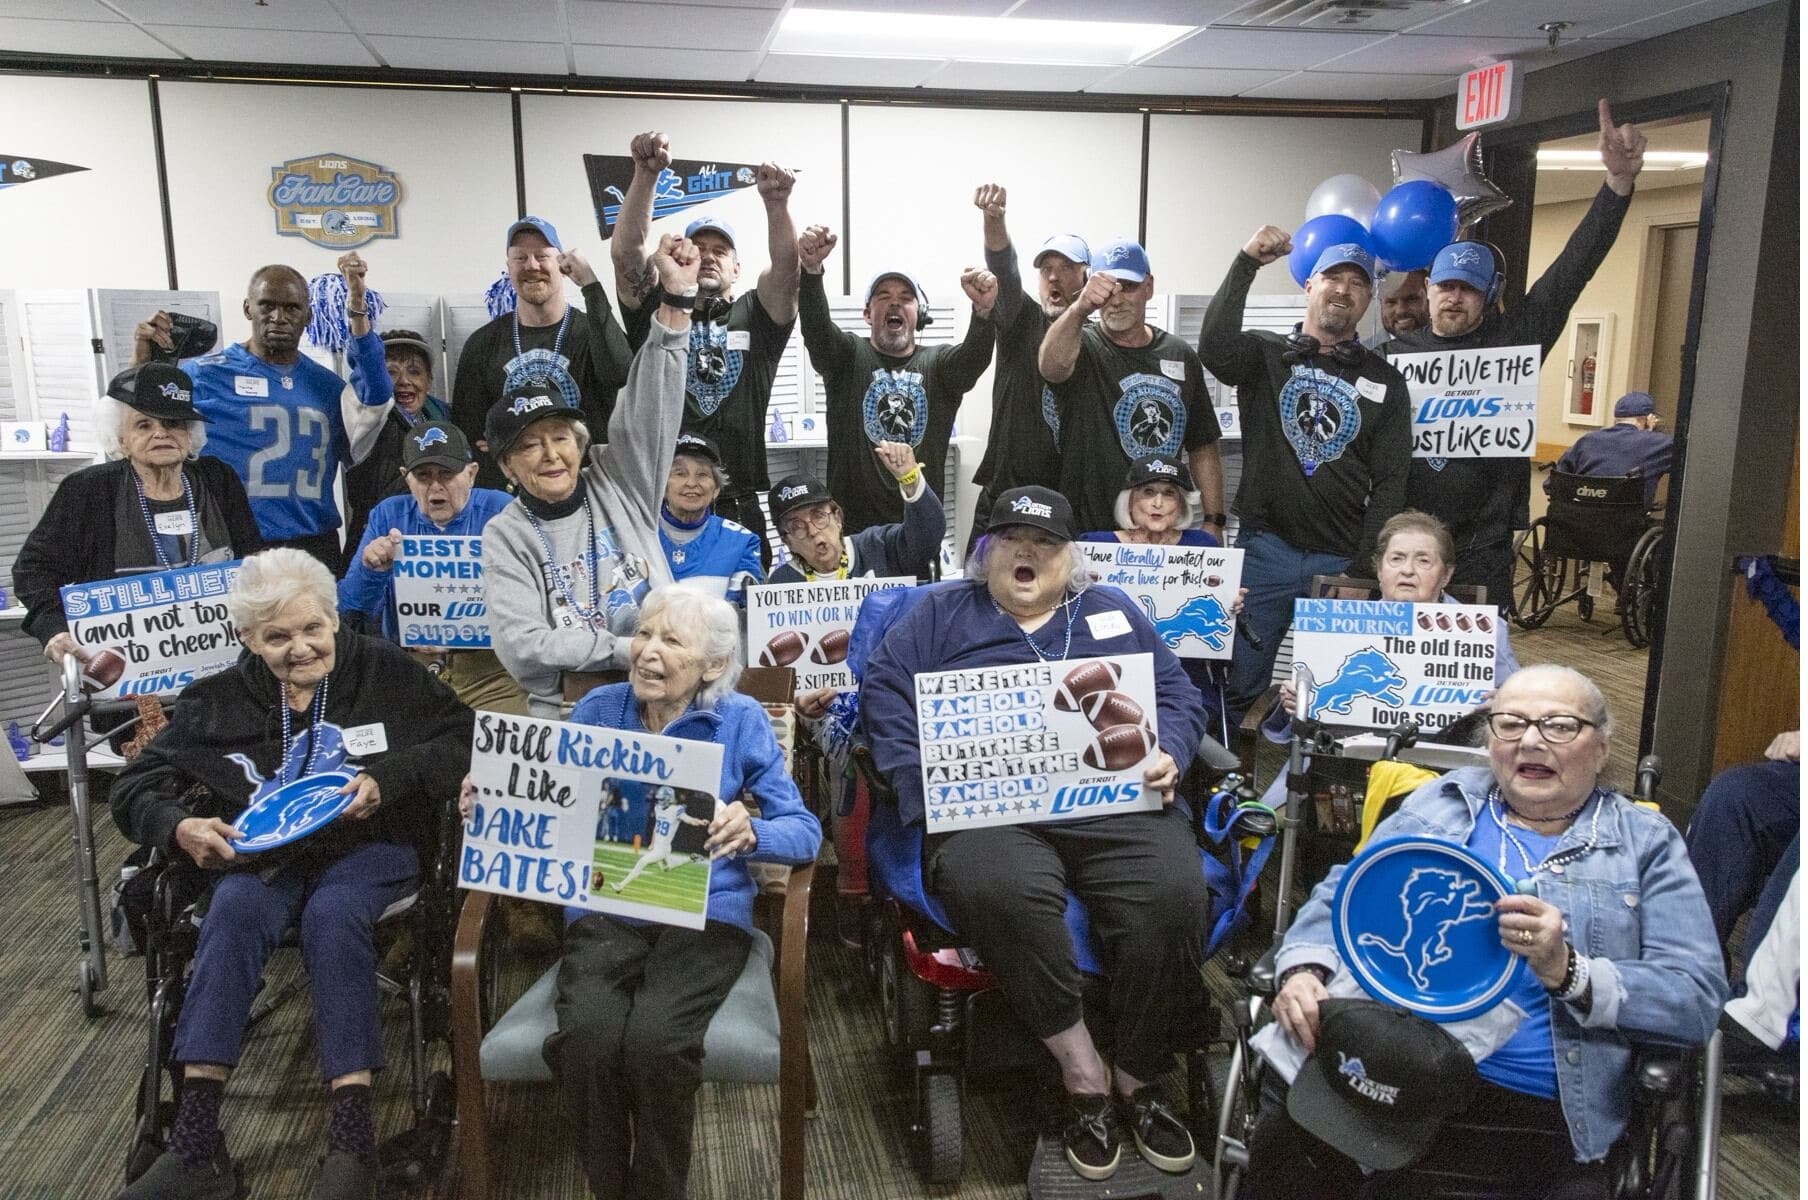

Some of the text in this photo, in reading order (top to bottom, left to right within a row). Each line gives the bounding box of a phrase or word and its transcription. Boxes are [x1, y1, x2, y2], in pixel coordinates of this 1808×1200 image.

[1465, 64, 1506, 123] EXIT
[687, 171, 732, 193] GRIT
[699, 164, 718, 177] ALL
[1495, 355, 1534, 385] THE
[1444, 389, 1481, 397] DETROIT
[1415, 397, 1504, 424] LIONS
[1495, 418, 1534, 452] US)
[247, 404, 330, 499] 23
[1576, 485, 1608, 498] drive
[403, 539, 464, 557] BEST
[1168, 550, 1206, 567] waited
[1207, 557, 1226, 567] our
[393, 560, 485, 579] MOMEN
[1107, 569, 1135, 584] entire
[1137, 569, 1159, 585] lives
[1163, 574, 1179, 591] for
[64, 577, 176, 616] STILL
[754, 588, 804, 608] YOU'RE
[807, 585, 849, 603] NEVER
[1294, 599, 1405, 617] IT'S RAINING
[398, 602, 441, 616] OUR
[443, 601, 487, 620] LIO
[768, 611, 785, 628] TO
[788, 608, 812, 627] WIN
[816, 605, 840, 625] (OR
[74, 602, 228, 646] (and not too
[1294, 616, 1409, 635] IT'S POURING
[124, 639, 150, 663] to
[1383, 636, 1495, 659] The old fans
[139, 666, 173, 678] DETROIT
[805, 671, 846, 690] SUPER
[918, 665, 1051, 695] WE'RE THE
[1424, 662, 1494, 681] and the
[921, 693, 992, 719] SAME
[1409, 684, 1490, 706] LIONS
[1372, 706, 1411, 726] love
[475, 714, 552, 763] Still
[922, 715, 993, 741] SAME
[925, 731, 1059, 763] BUT THESE
[926, 752, 1079, 785] AREN'T THE
[1079, 775, 1117, 785] DETROIT
[928, 775, 1049, 806] SAME OLD
[1049, 782, 1142, 815] LIONS
[466, 803, 557, 850] JAKE
[461, 846, 591, 902] BATES!
